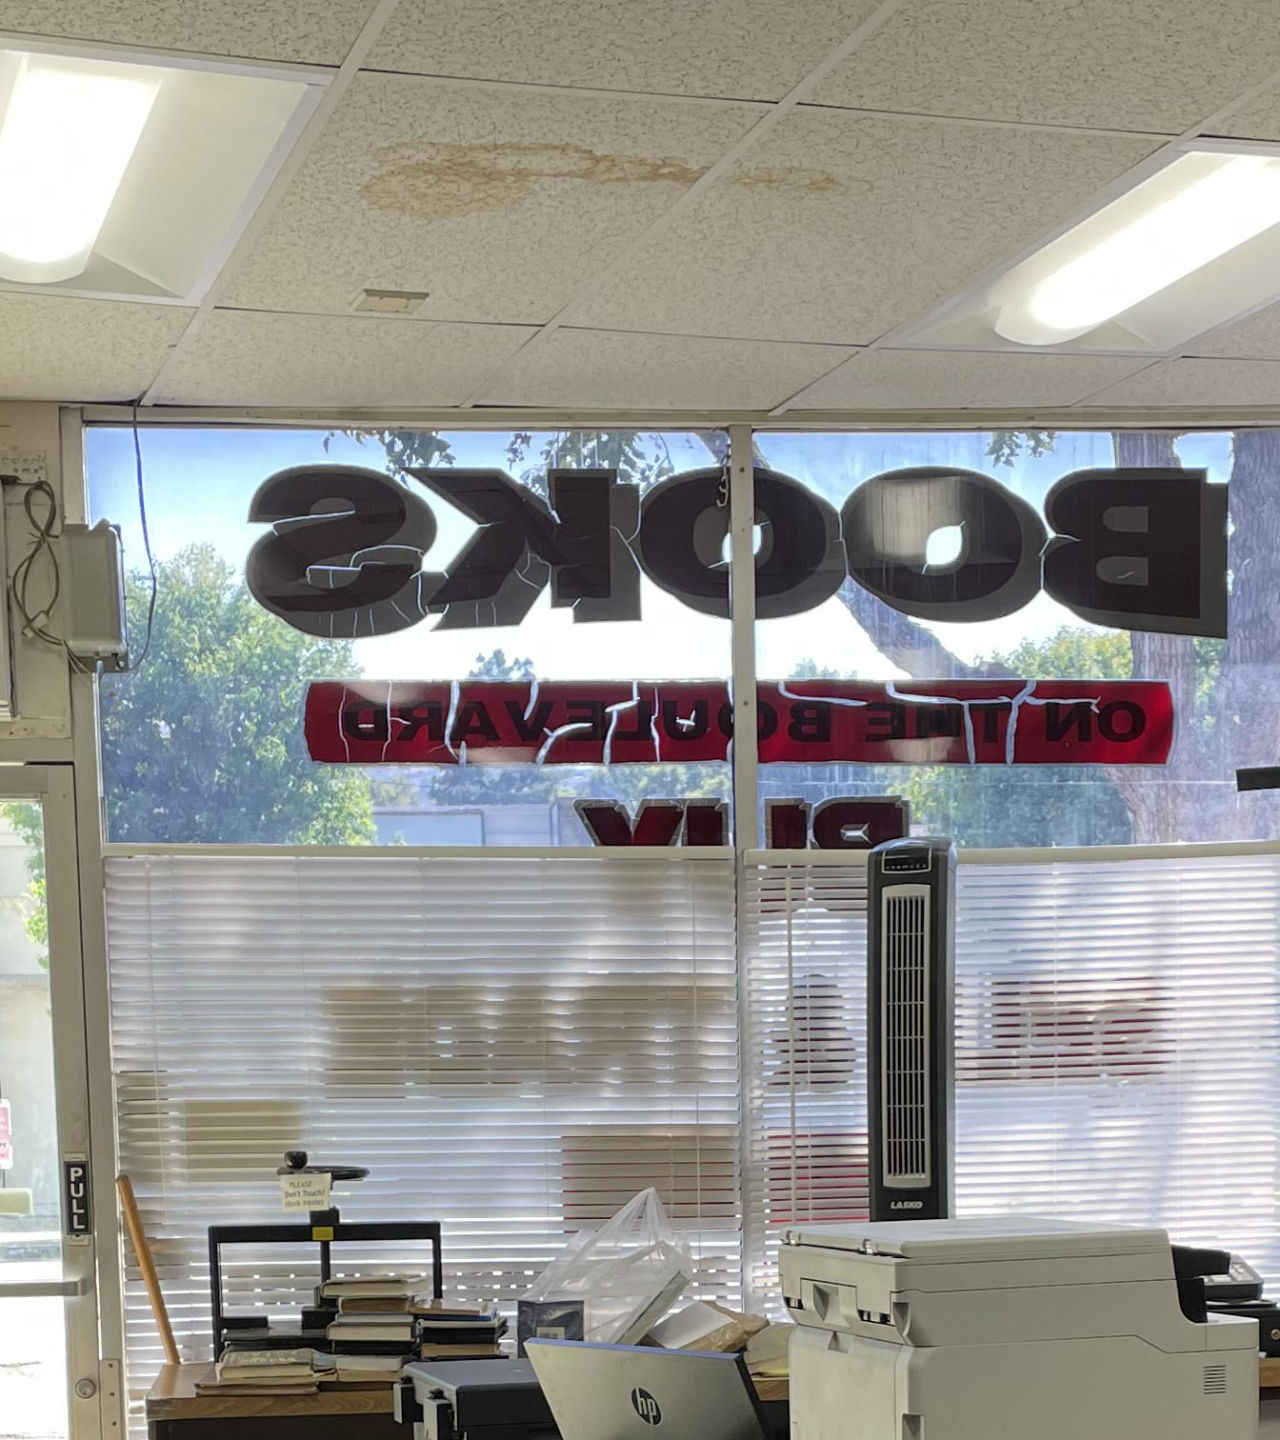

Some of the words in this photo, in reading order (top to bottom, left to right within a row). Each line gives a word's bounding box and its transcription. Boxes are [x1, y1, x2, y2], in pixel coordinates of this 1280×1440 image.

[69, 1167, 84, 1230] PULL
[889, 1200, 924, 1210] LASKO
[636, 1386, 660, 1424] hp
